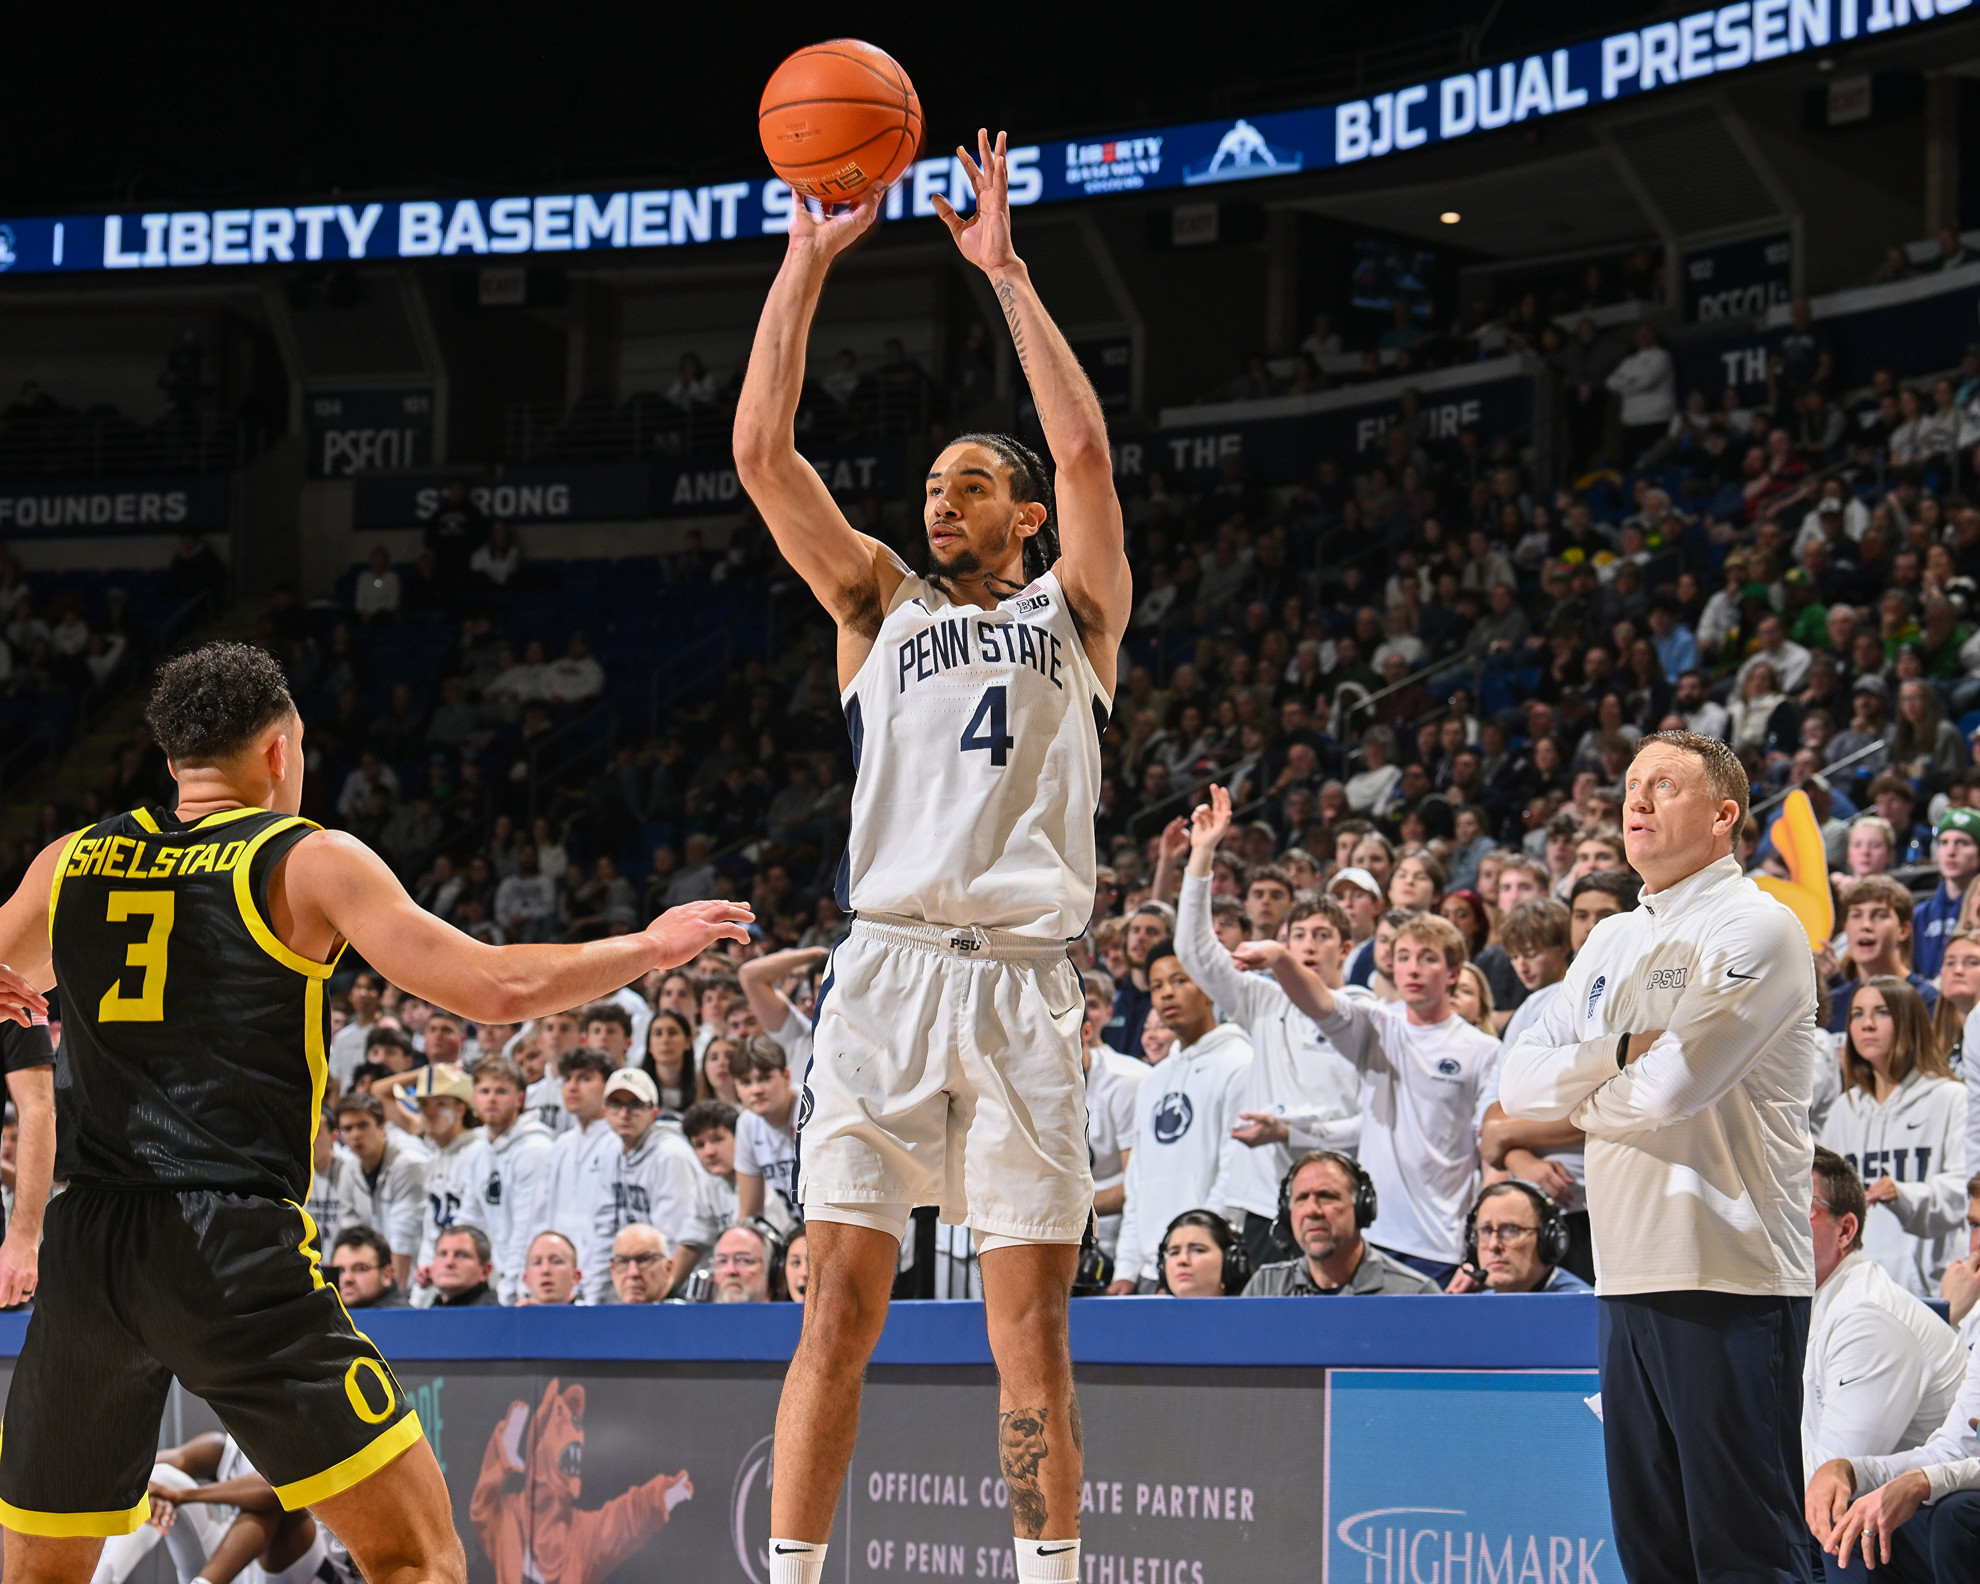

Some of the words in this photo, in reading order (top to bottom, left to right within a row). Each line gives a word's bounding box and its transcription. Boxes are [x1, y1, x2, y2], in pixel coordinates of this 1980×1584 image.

[1334, 86, 1428, 164] BJC
[1440, 49, 1588, 140] DUAL
[103, 204, 383, 269] LIBERTY
[399, 182, 748, 257] BASEMENT
[672, 470, 740, 505] AND
[899, 617, 971, 694] PENN
[977, 620, 1063, 690] STATE
[960, 686, 1014, 766] 4
[66, 835, 247, 879] SHELSTAD
[98, 891, 175, 1022] 3
[1647, 968, 1688, 990] PSU
[868, 1471, 968, 1506] OFFICIAL
[1136, 1485, 1256, 1522] PARTNER
[867, 1539, 895, 1569] OF
[905, 1542, 965, 1576] PENN
[1366, 1526, 1605, 1584] HIGHMARK
